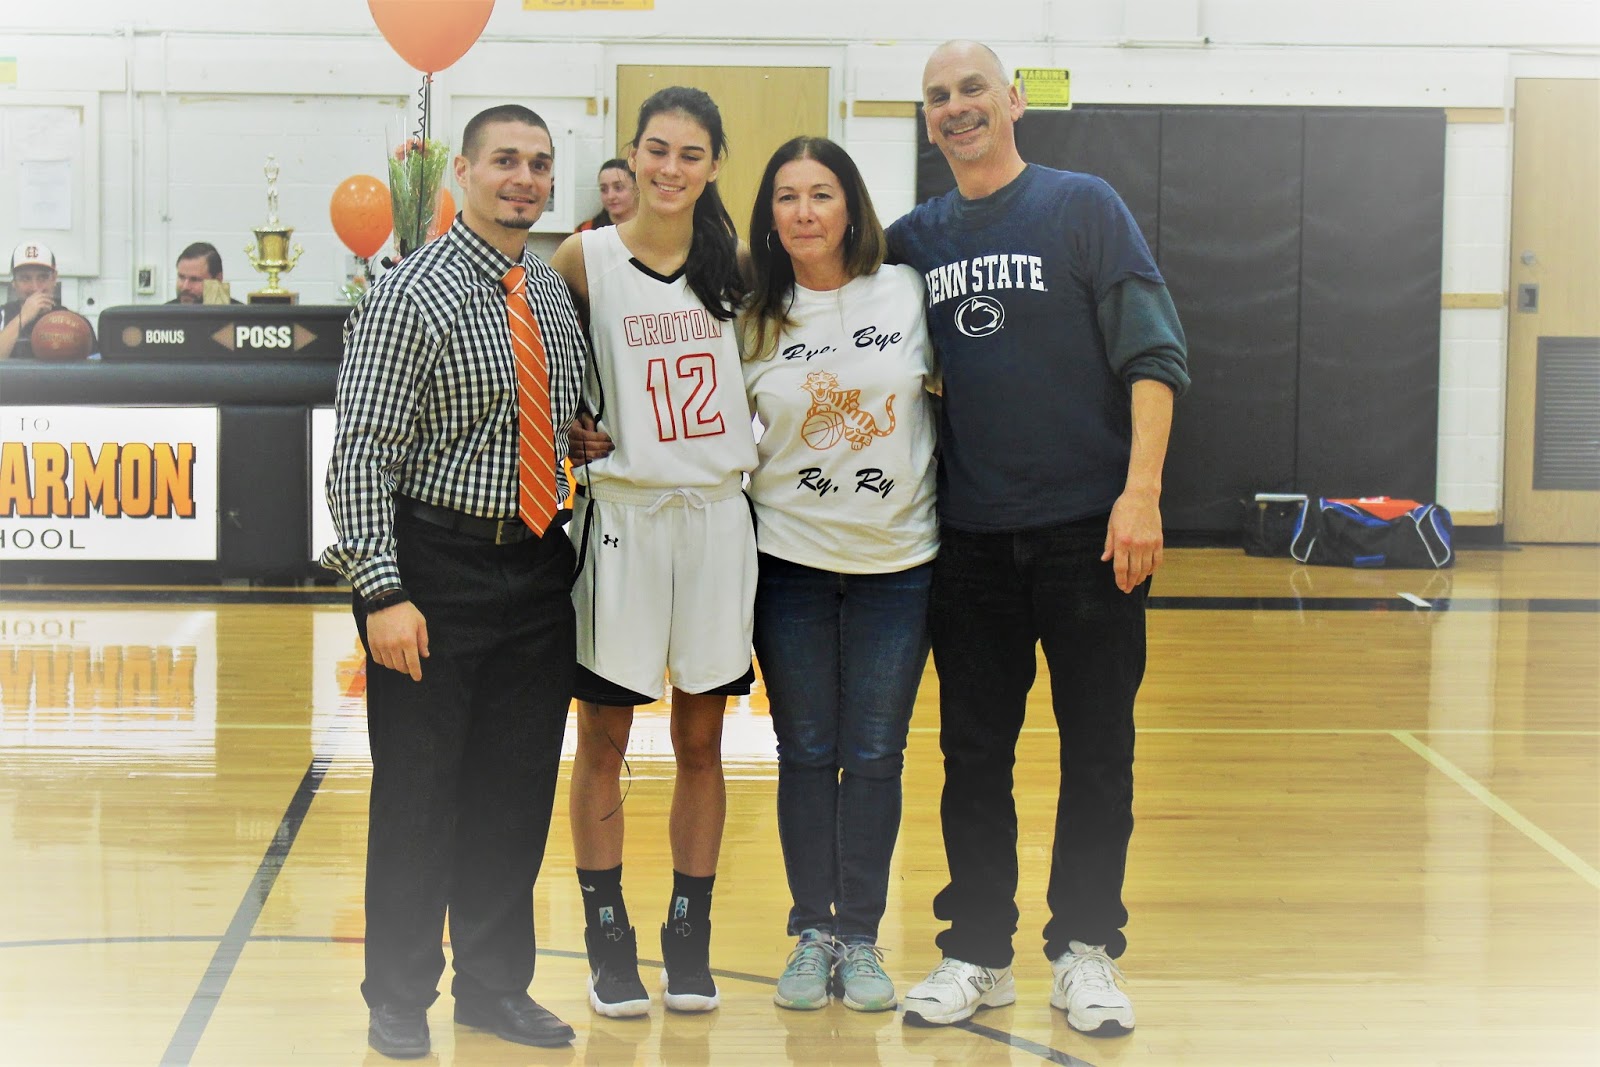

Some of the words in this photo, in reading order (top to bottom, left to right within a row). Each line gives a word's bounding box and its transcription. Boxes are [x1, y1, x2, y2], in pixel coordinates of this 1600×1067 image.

[972, 253, 1045, 293] STATE
[145, 329, 185, 344] BONUS
[235, 325, 292, 349] POSS
[623, 308, 722, 347] CROTON
[852, 325, 902, 352] Bye
[646, 352, 726, 443] 12
[19, 417, 51, 432] TO
[0, 441, 197, 519] ARMON
[796, 466, 839, 498] Ry,
[855, 467, 895, 499] Ry
